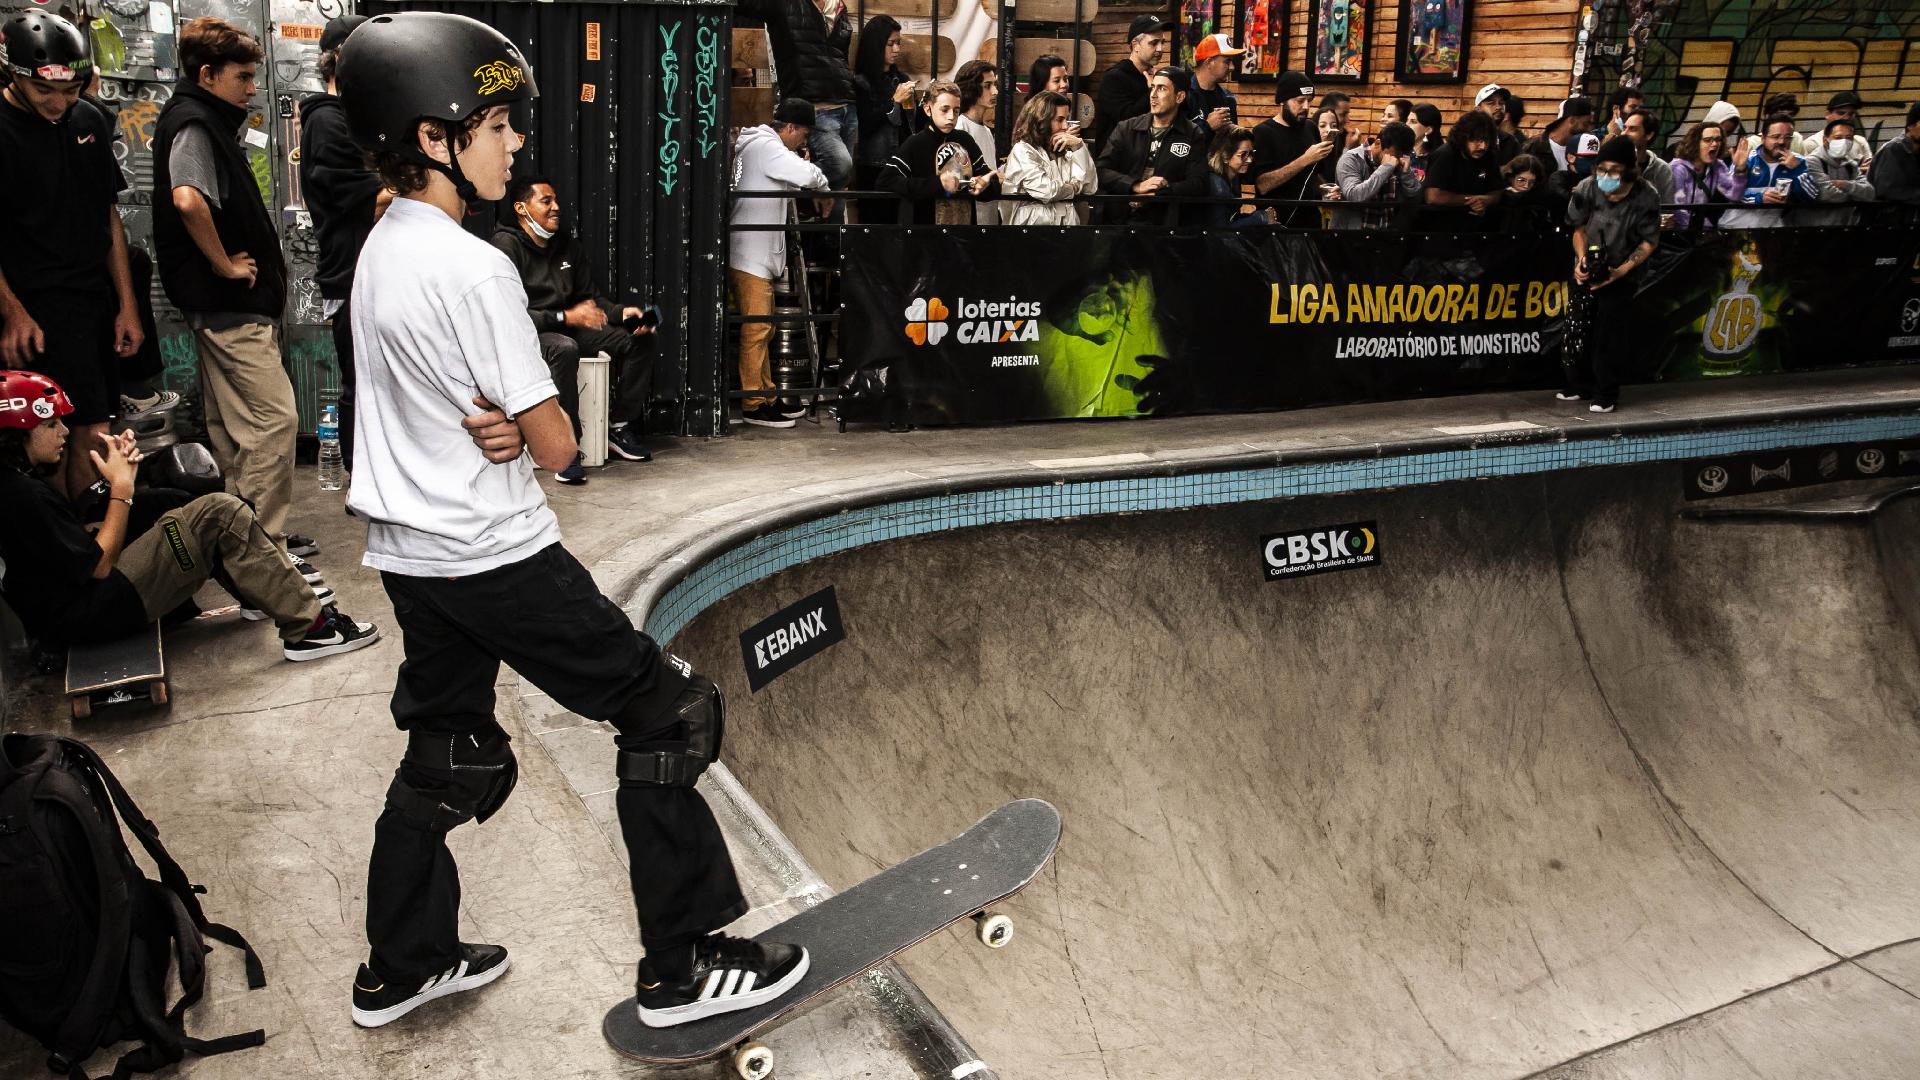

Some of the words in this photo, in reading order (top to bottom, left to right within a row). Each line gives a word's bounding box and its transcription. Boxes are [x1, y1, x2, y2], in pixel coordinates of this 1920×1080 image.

[281, 25, 299, 37] POSERS
[300, 27, 312, 38] FUCK
[1172, 144, 1188, 154] DEUS
[957, 295, 1042, 319] loterias
[1269, 283, 1340, 324] LIGA
[1346, 283, 1480, 324] AMADORA
[1484, 283, 1521, 320] DE
[1524, 281, 1569, 319] BO
[956, 320, 1040, 344] CAIXA
[1710, 297, 1757, 351] LAB
[1335, 330, 1438, 359] LABORATÓRIO
[1440, 335, 1458, 356] DE
[1460, 331, 1541, 356] MONSTROS
[991, 354, 1040, 368] APRESENTA
[1264, 530, 1353, 568] CBSK
[1270, 562, 1316, 576] Confederação
[1316, 559, 1346, 569] Brasileira
[1346, 556, 1356, 564] de
[1356, 554, 1374, 563] Skate
[765, 606, 828, 662] EBANX
